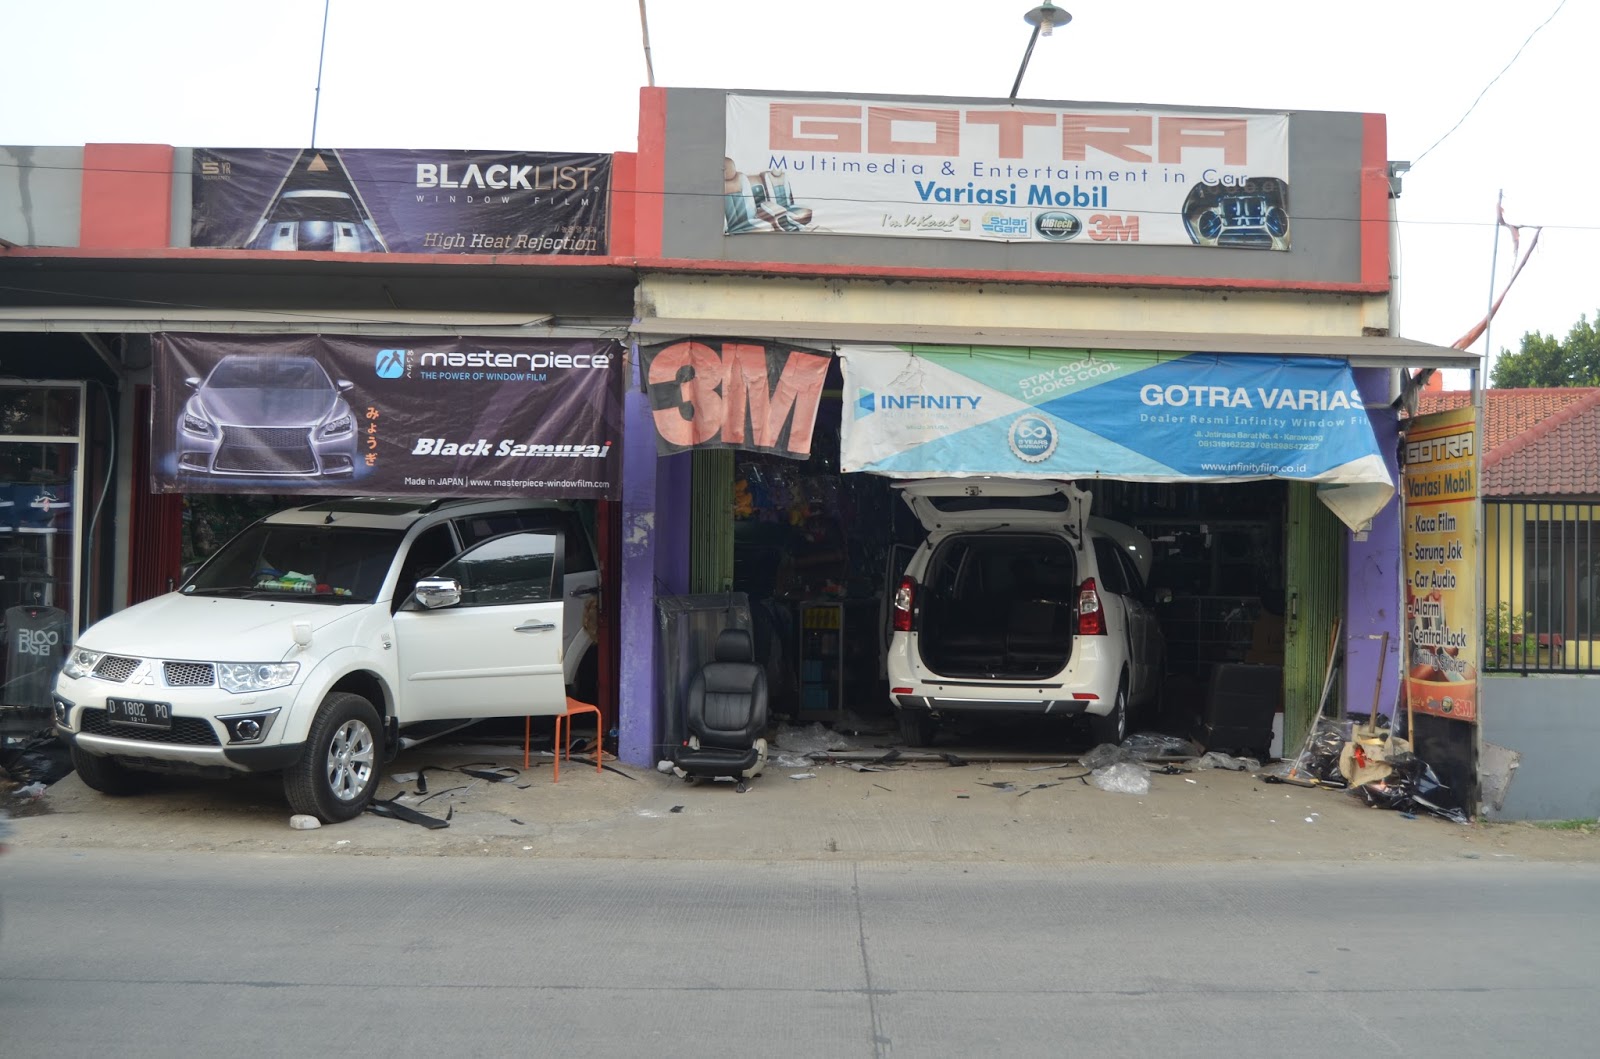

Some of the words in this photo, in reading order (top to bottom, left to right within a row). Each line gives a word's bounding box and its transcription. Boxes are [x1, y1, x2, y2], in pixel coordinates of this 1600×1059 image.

[769, 103, 1247, 166] GOTRA
[416, 163, 596, 191] BLACKLIST
[768, 154, 924, 176] Multimedia
[940, 160, 956, 177] &
[973, 161, 1148, 182] Entertaiment
[1163, 169, 1185, 184] in
[1202, 168, 1249, 187] Car
[914, 180, 1017, 207] Variasi
[1027, 184, 1108, 208] Mobil
[991, 216, 1027, 226] Solar
[1041, 218, 1073, 229] MBtech
[1088, 213, 1140, 242] 3M
[423, 233, 465, 250] High
[470, 234, 512, 249] Heat
[514, 234, 597, 251] Rejection
[420, 350, 609, 371] masterpiece
[421, 372, 437, 380] THE
[440, 372, 471, 380] POWER
[486, 373, 524, 381] WINDOW
[527, 373, 547, 381] FILM
[1018, 370, 1055, 389] STAY
[1023, 374, 1076, 399] LOOKS
[1077, 362, 1121, 381] COOL
[648, 342, 831, 454] 3M
[881, 395, 982, 409] INFINITY
[1139, 384, 1252, 408] GOTRA
[1140, 413, 1185, 423] Dealer
[1190, 415, 1229, 425] Resmi
[1234, 416, 1286, 427] Infinity
[1291, 418, 1345, 427] Window
[1350, 416, 1370, 425] Fil
[365, 406, 380, 467] みょうぎ
[1237, 431, 1258, 439] Barat
[1284, 433, 1324, 441] Karawang
[411, 438, 493, 456] Black
[495, 440, 612, 458] Samurai
[1406, 431, 1474, 465] GOTRA
[1201, 462, 1307, 473] www.infinityfilm.co.id
[404, 477, 426, 486] Made
[427, 477, 436, 486] in
[437, 478, 464, 486] JAPAN
[470, 479, 492, 487] www.
[494, 479, 610, 489] masterpiece-windowfilm.com
[1408, 475, 1441, 497] Variasi
[1444, 469, 1470, 494] Mobil
[1415, 515, 1436, 533] Kaca
[1438, 512, 1456, 531] Film
[1415, 542, 1444, 564] Sarung
[1447, 540, 1462, 559] Jok
[1414, 570, 1429, 588] Car
[1431, 569, 1456, 588] Audio
[1413, 598, 1439, 617] Alarm
[109, 699, 116, 714] D
[123, 700, 146, 717] 1802
